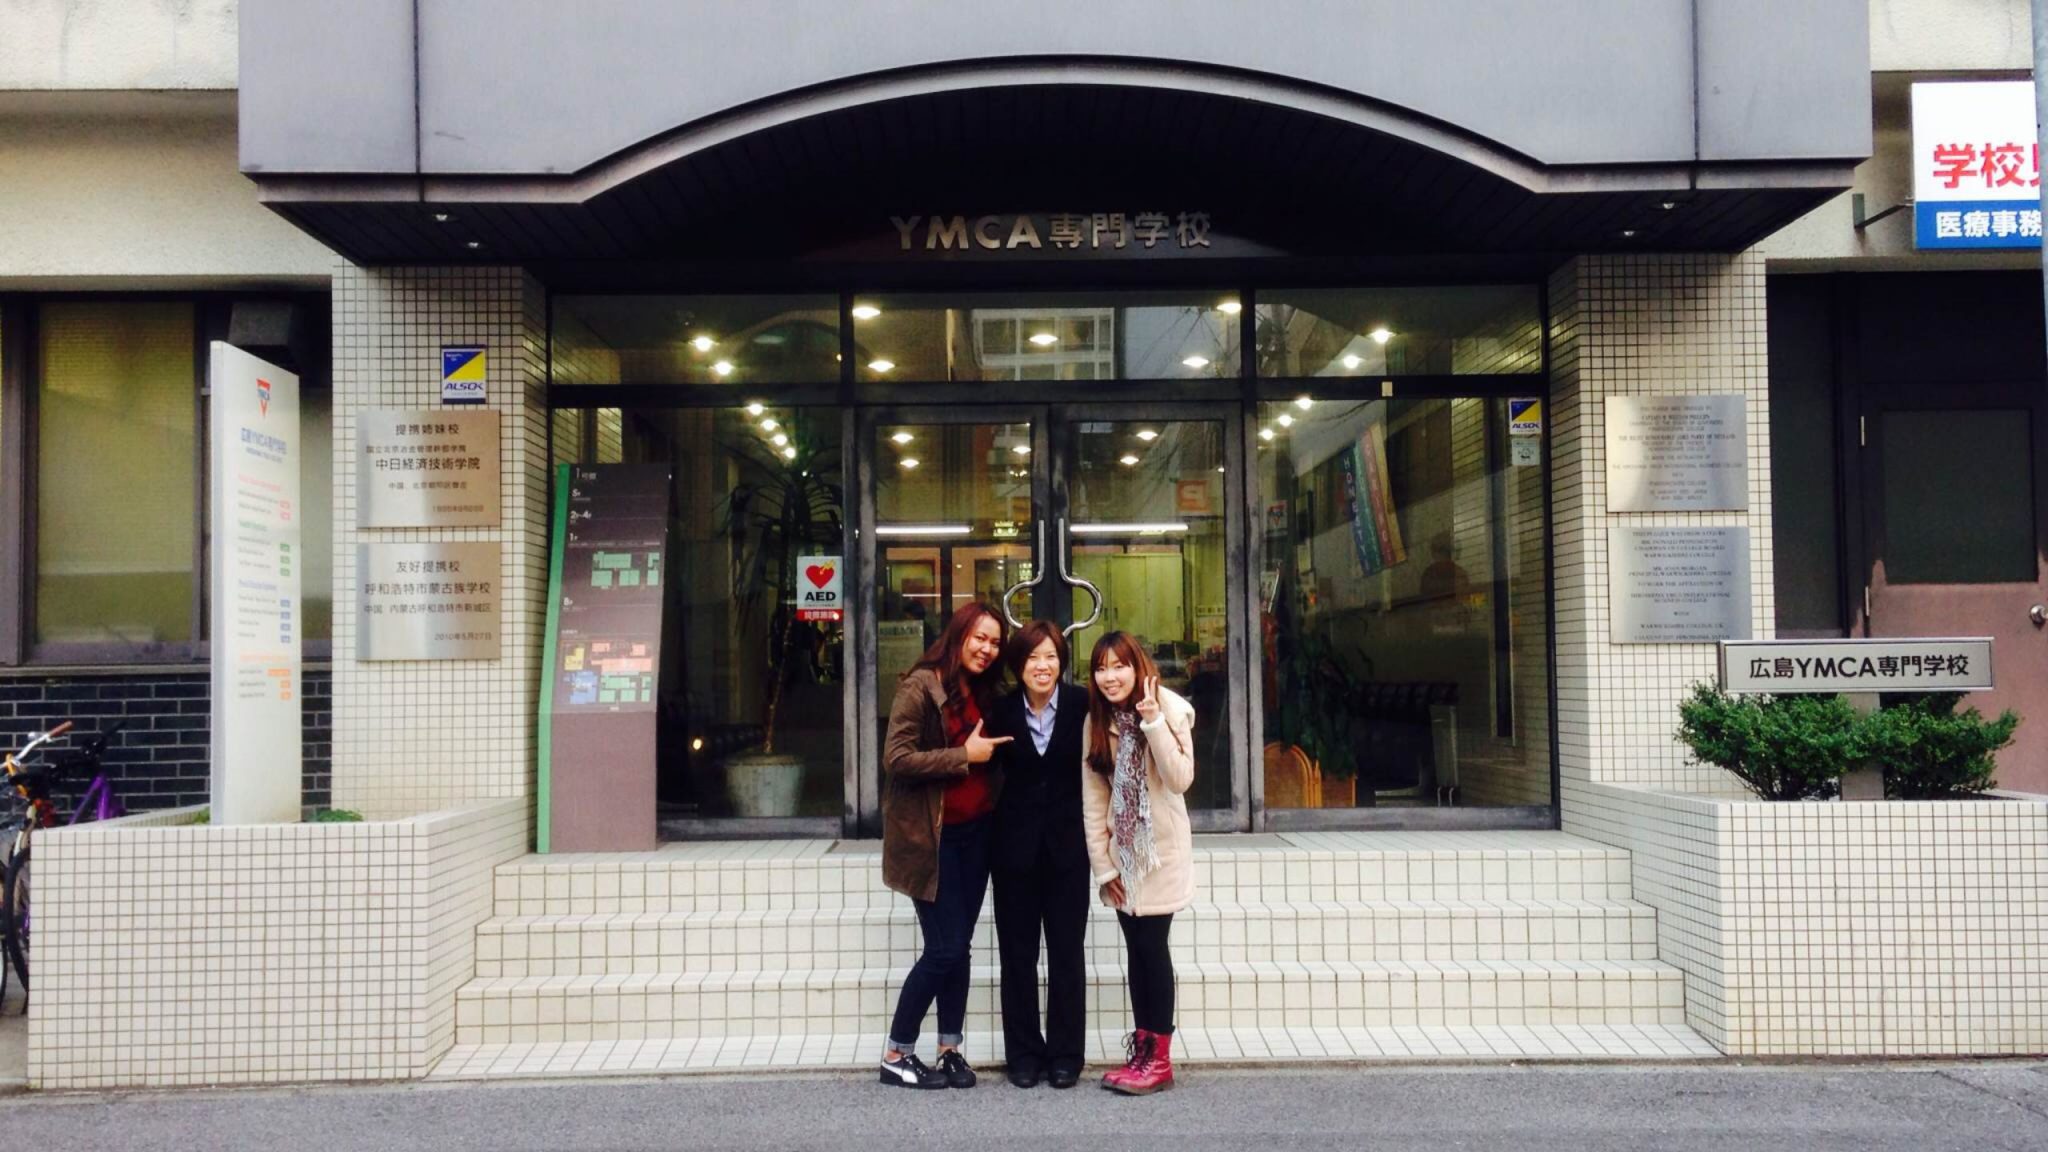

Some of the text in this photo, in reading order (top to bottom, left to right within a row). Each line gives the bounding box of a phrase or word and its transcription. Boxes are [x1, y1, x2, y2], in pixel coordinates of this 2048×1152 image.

[1933, 142, 2041, 190] 学校
[889, 211, 1212, 249] YMCA専門学校
[445, 382, 484, 391] ALSOK
[395, 424, 460, 436] 提携姉妹校
[375, 457, 481, 470] 中日経済技術学院
[396, 560, 461, 573] 友好提携校
[805, 591, 836, 601] AED
[1749, 653, 1970, 679] 広島YMCA専門学校
